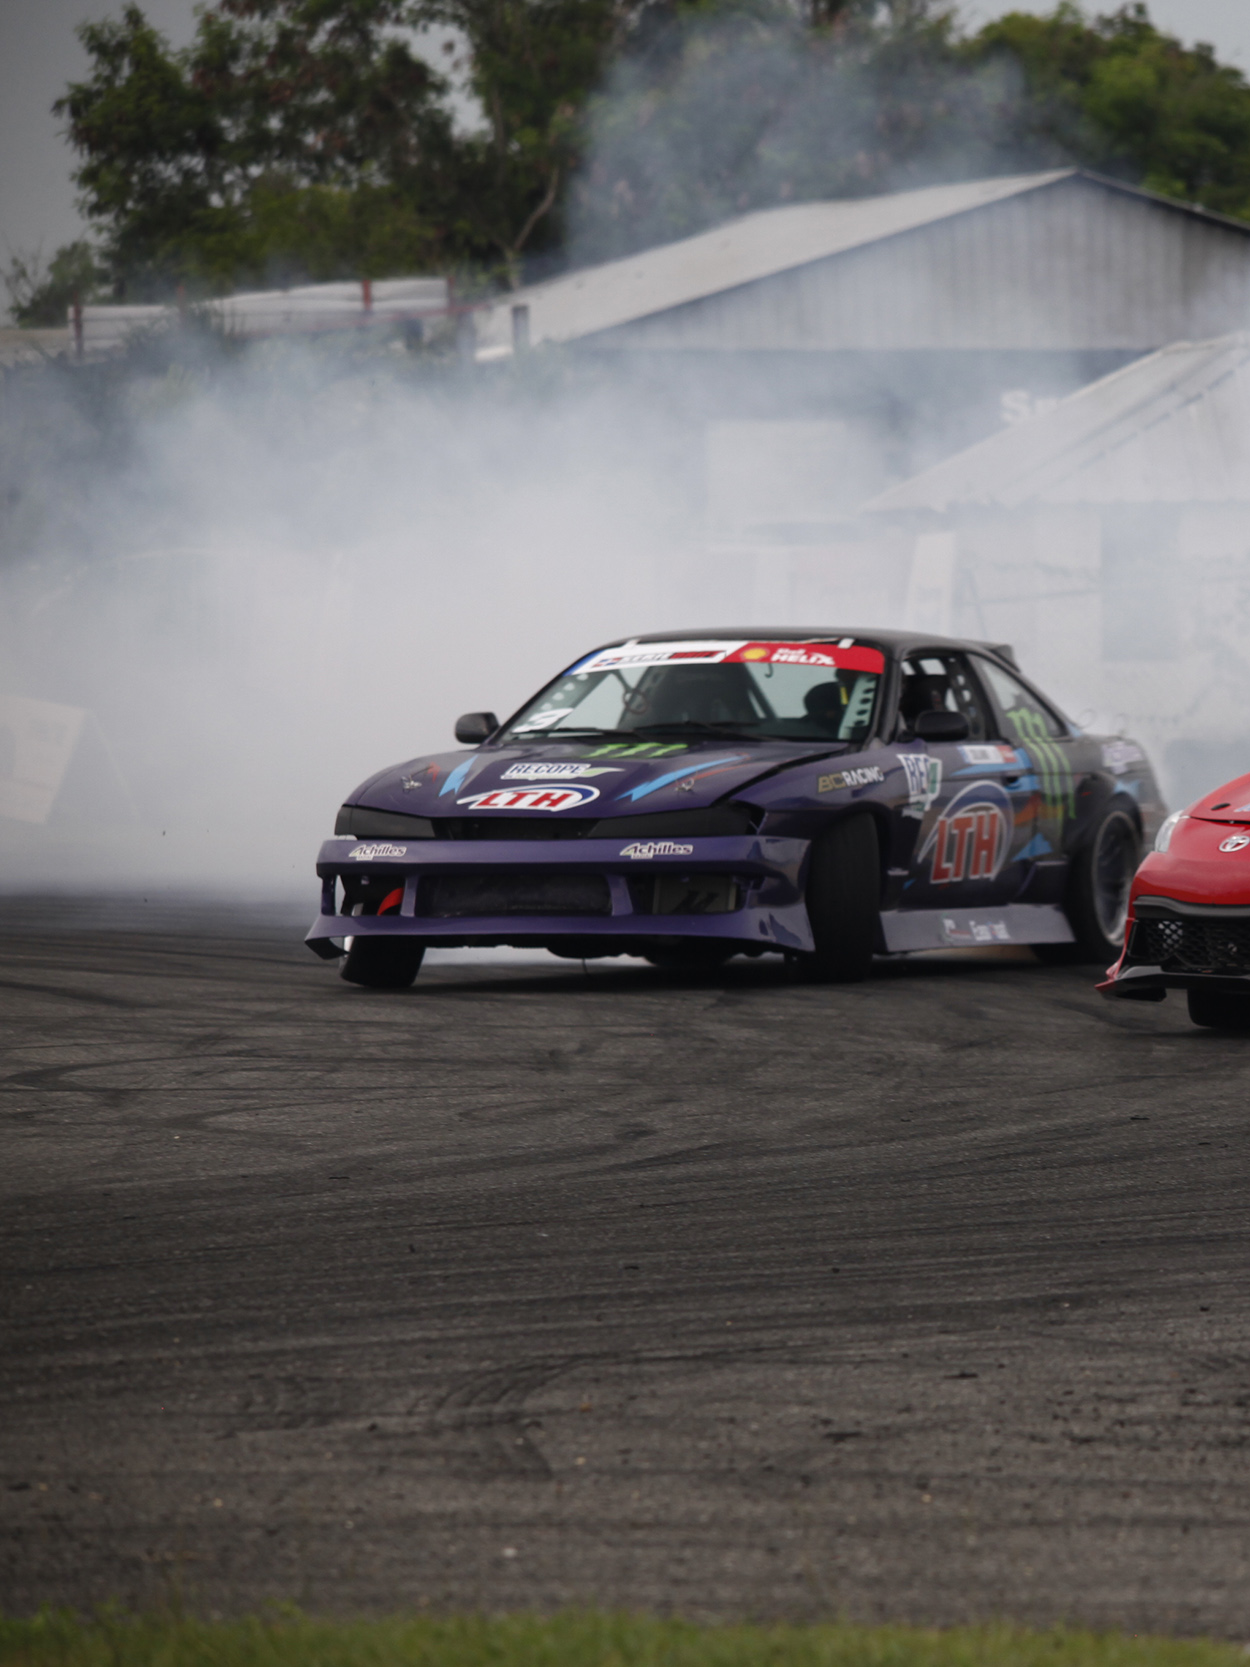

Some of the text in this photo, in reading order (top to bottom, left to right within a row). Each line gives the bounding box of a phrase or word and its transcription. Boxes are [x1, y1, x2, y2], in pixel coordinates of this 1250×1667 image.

[771, 652, 835, 665] HELIX
[509, 763, 582, 775] RECOPE
[843, 766, 884, 786] RACING
[475, 791, 574, 808] LTH
[348, 843, 407, 857] Achilles
[620, 842, 693, 856] Achilles
[930, 811, 1000, 884] LTH
